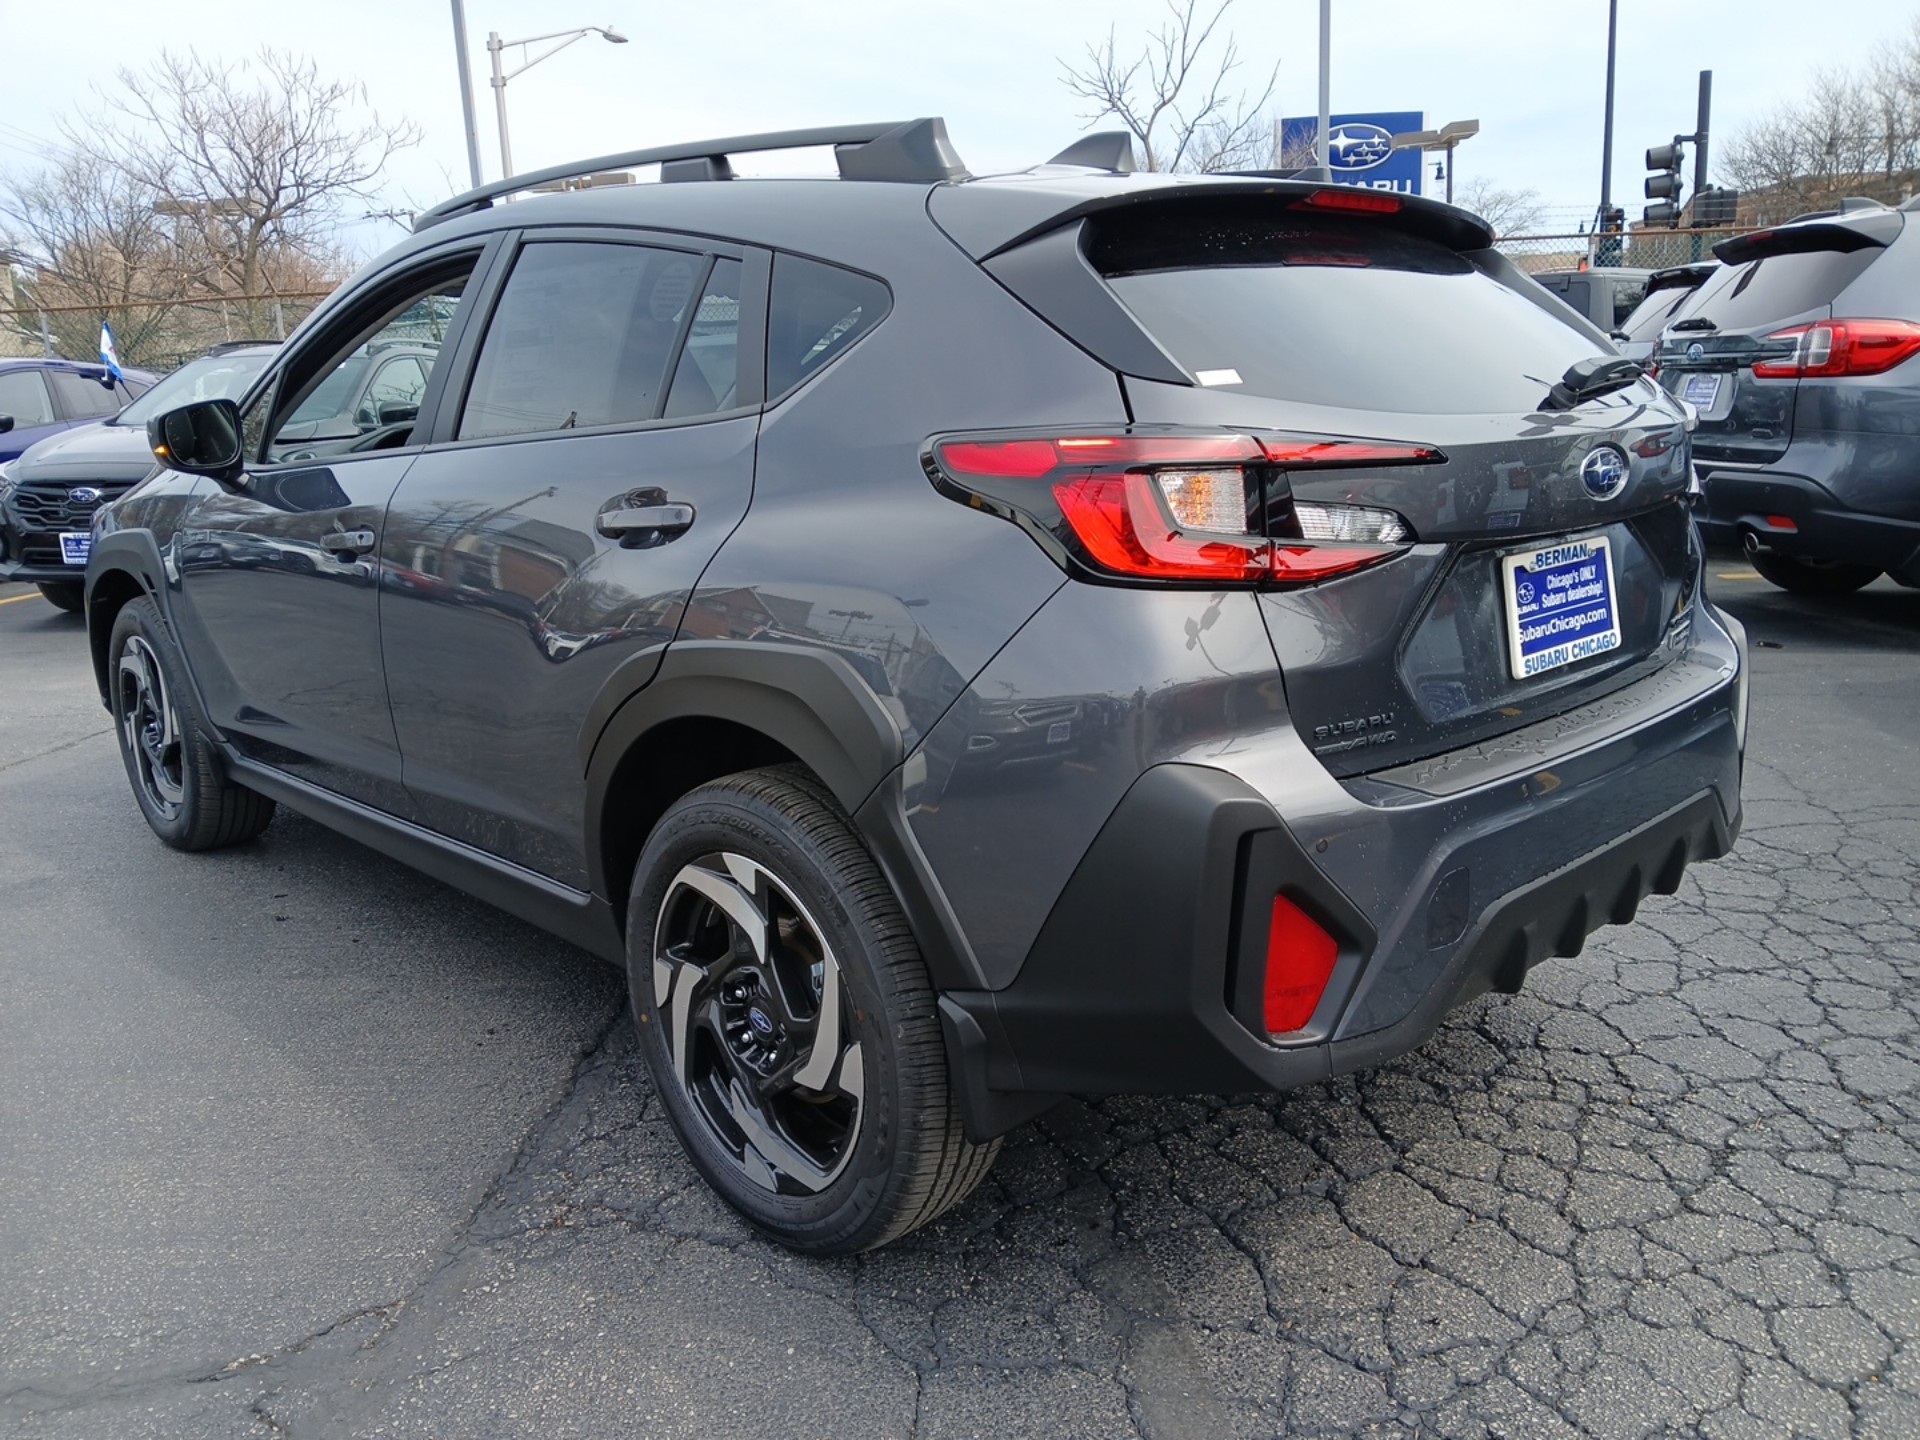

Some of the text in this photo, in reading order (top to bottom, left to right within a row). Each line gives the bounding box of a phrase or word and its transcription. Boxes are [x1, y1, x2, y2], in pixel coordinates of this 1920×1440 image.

[1535, 543, 1588, 569] BERMAN
[1546, 564, 1597, 590] Chicago's ONLY
[1541, 580, 1604, 609] Subaru dealership!
[1519, 607, 1607, 643] SubaruChicago.com
[1524, 631, 1618, 675] SUBARU CHICAGO
[1314, 712, 1394, 738] SUBARU
